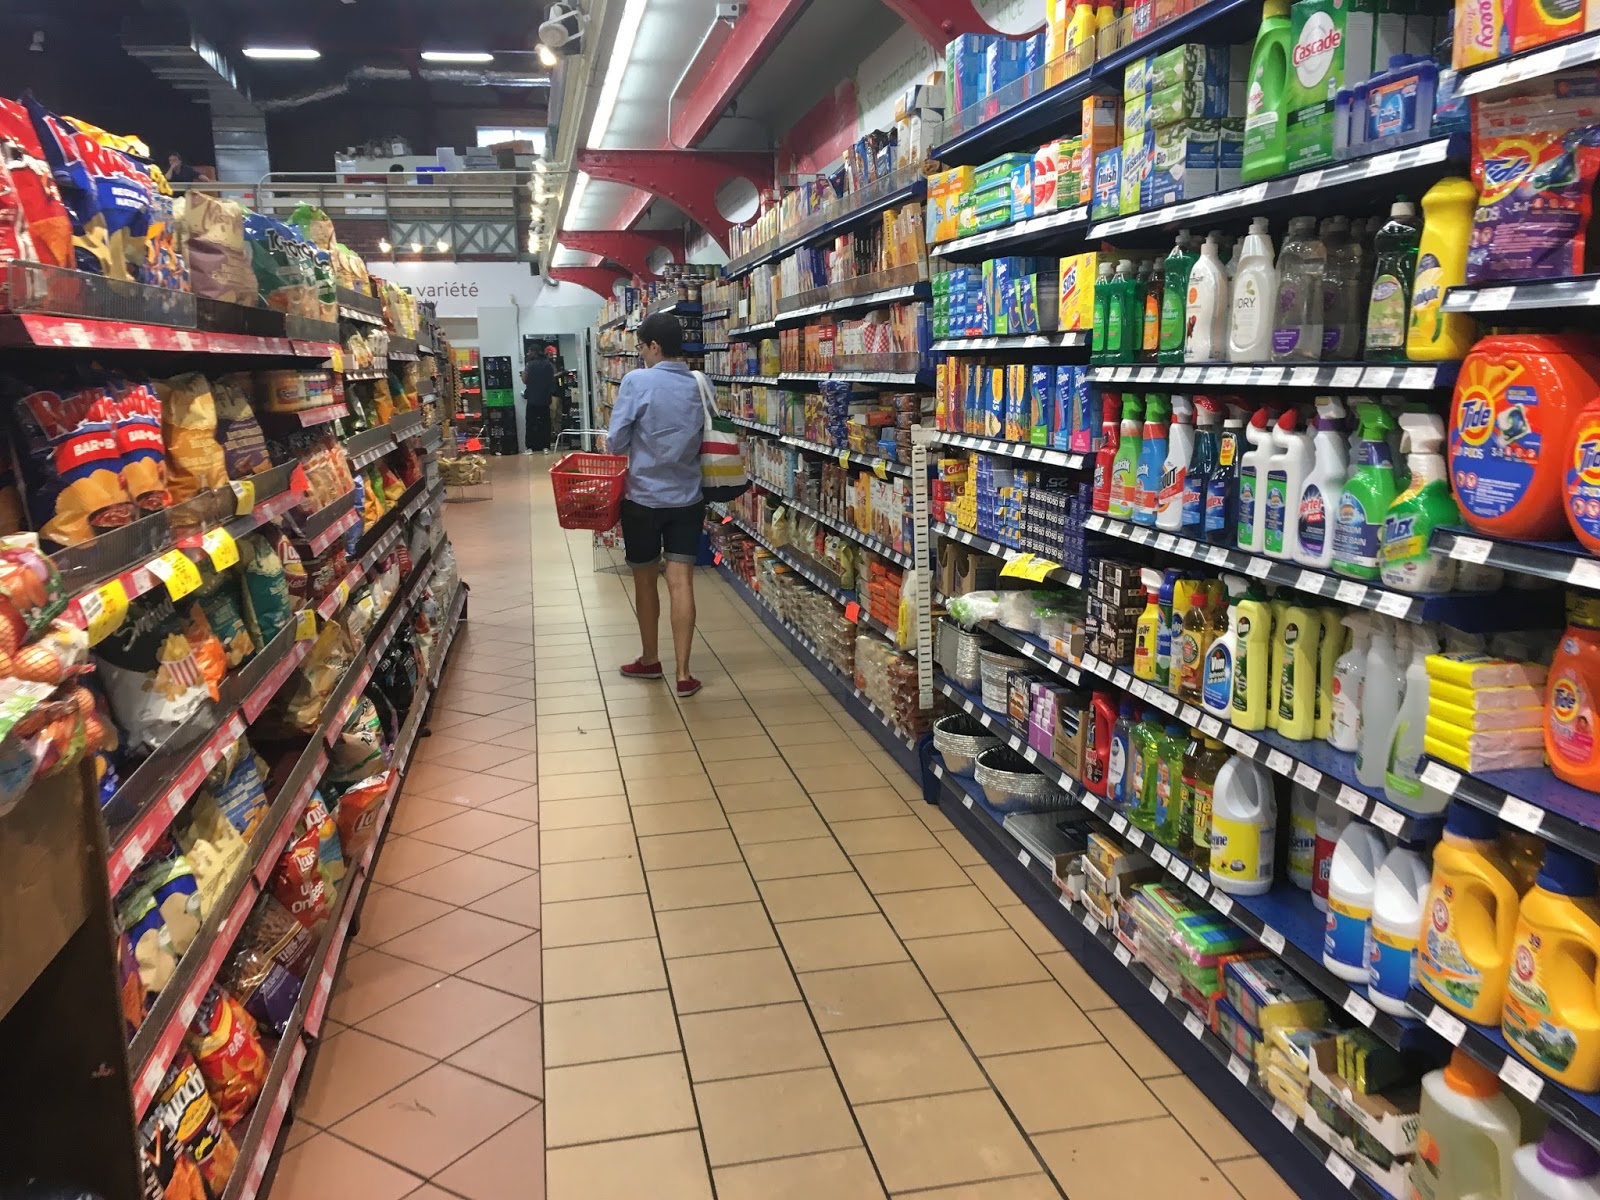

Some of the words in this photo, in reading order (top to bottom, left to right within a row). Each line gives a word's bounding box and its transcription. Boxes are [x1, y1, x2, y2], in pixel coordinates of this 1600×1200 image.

[1293, 30, 1341, 65] Cascade
[416, 281, 479, 297] variété
[1238, 297, 1256, 309] ORY
[1461, 400, 1491, 433] Tide
[1160, 466, 1177, 489] OUT
[283, 541, 302, 564] La
[1211, 656, 1225, 672] Vim
[1195, 799, 1211, 813] ne
[1194, 813, 1206, 829] ol
